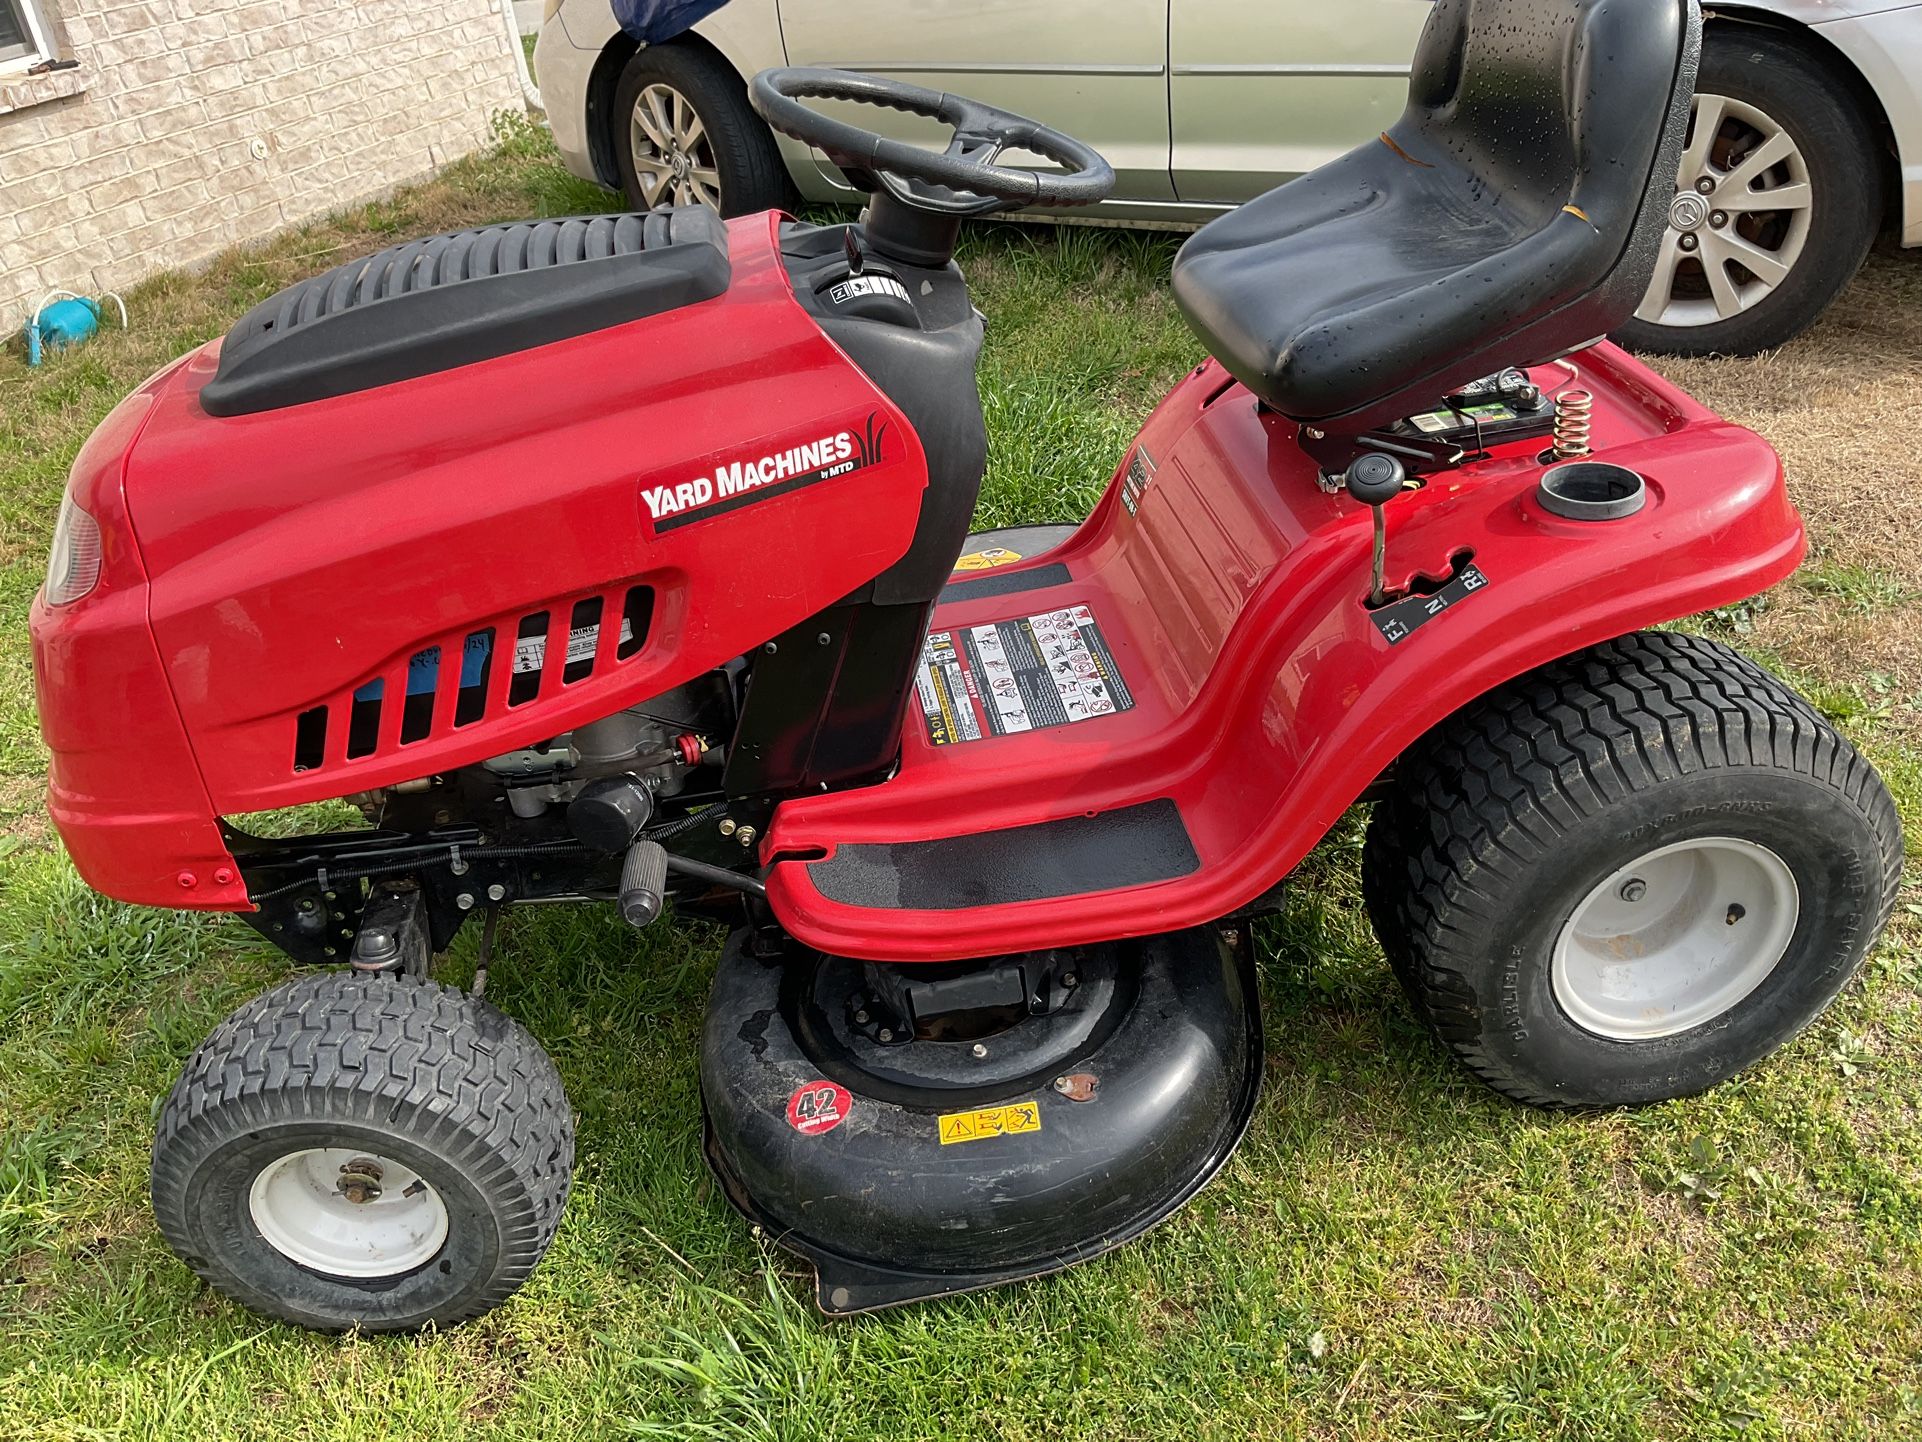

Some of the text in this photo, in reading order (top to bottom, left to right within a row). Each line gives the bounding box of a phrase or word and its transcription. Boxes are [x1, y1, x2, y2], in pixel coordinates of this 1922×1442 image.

[640, 432, 852, 519] YARD MACHINES
[820, 461, 854, 480] by MTD
[1463, 575, 1482, 591] R
[1424, 598, 1443, 615] N
[1387, 629, 1404, 642] F
[963, 669, 977, 694] DANGER
[1503, 944, 1529, 1043] CARLISLE
[797, 1113, 840, 1130] Cutting Width
